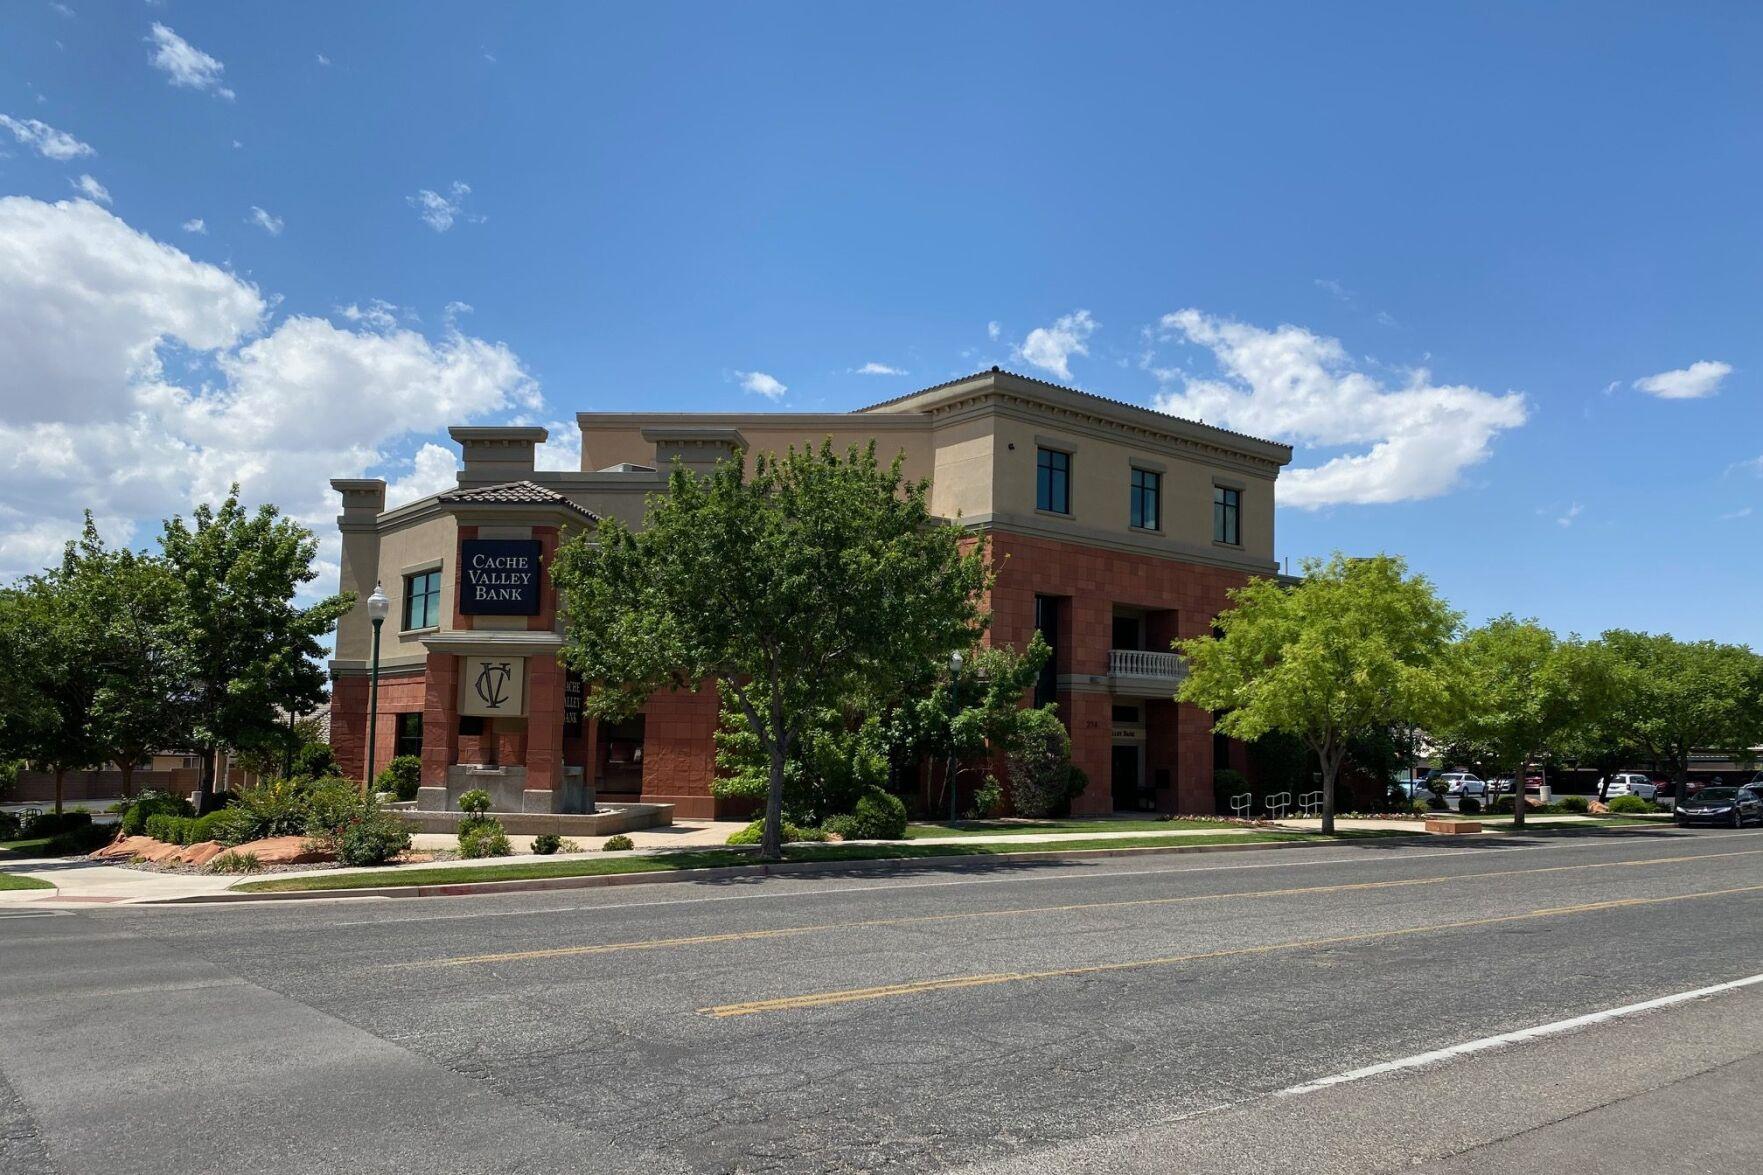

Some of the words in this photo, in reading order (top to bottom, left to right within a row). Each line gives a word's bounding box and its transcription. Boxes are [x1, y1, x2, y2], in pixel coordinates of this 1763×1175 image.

[472, 554, 529, 569] CACHE
[468, 570, 531, 585] VALLEY
[475, 586, 522, 601] BANK
